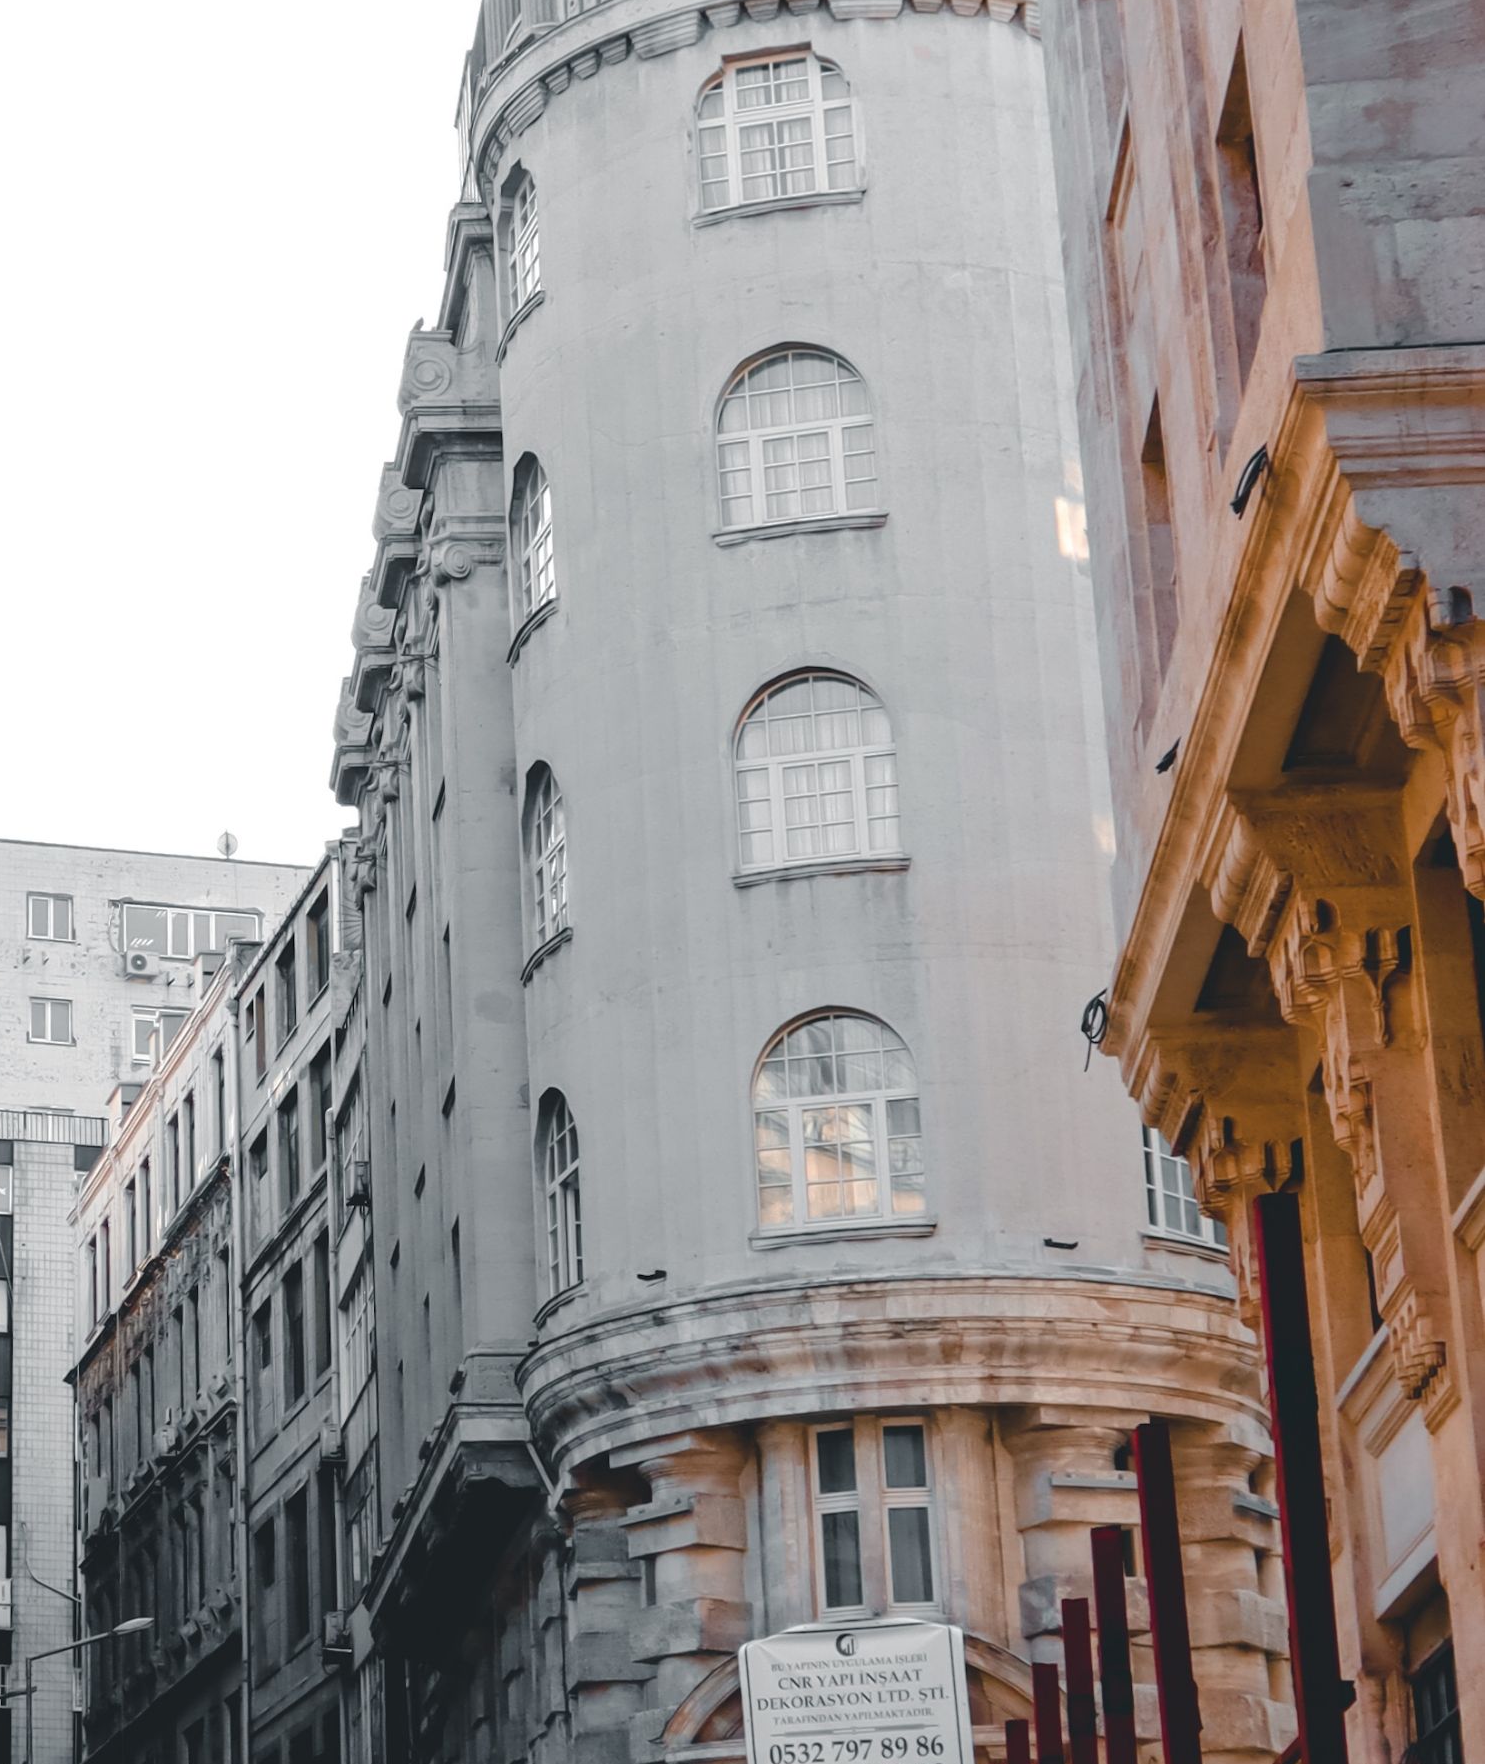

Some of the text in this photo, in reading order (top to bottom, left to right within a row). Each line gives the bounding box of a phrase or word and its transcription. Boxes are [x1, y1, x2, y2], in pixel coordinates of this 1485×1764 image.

[771, 1653, 928, 1673] BU YAPININ UYGULAMA İŞLERİ
[778, 1669, 923, 1691] CNR YAPI İNŞAAT
[757, 1684, 950, 1712] DEKORASYON LTD. ŞTİ.
[773, 1712, 842, 1726] TARAFINDAN
[831, 1739, 873, 1762] 797
[880, 1736, 908, 1759] 89
[916, 1734, 944, 1757] 86
